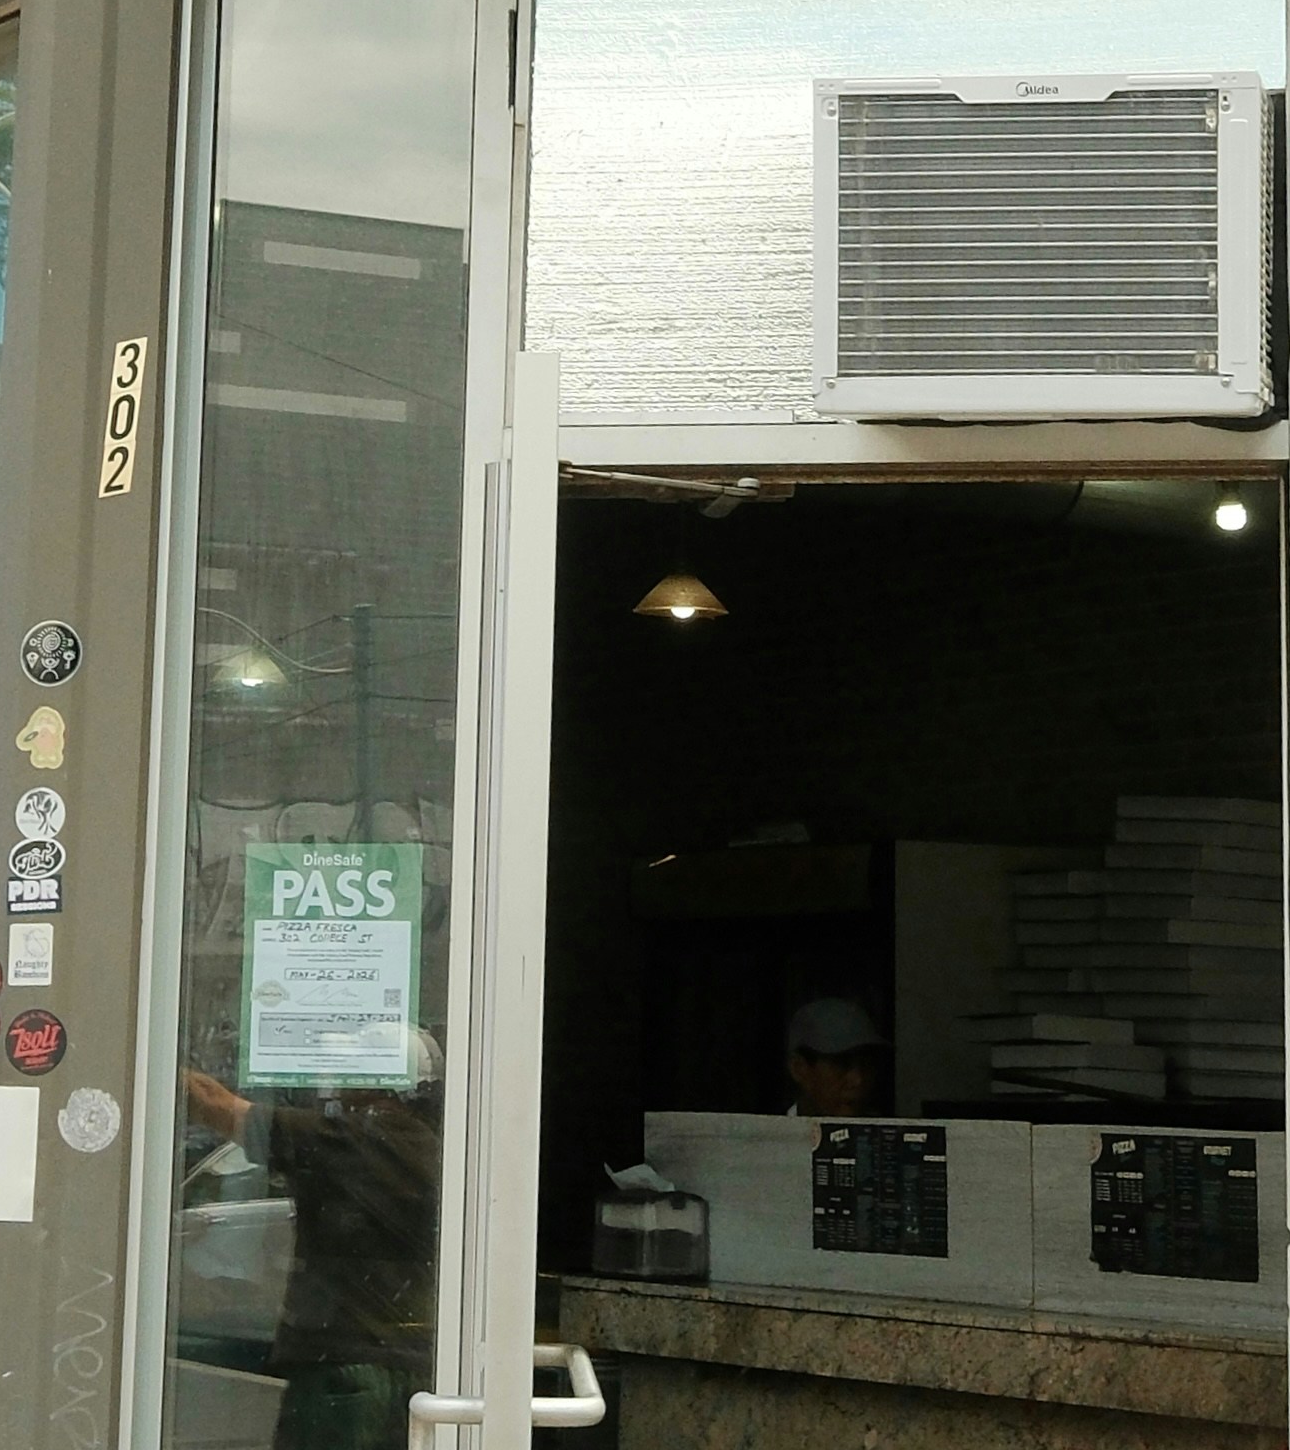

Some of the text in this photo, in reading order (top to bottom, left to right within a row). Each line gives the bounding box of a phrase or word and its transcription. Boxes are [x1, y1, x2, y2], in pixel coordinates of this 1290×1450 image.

[1015, 81, 1060, 98] Midea
[103, 342, 141, 494] 302
[303, 851, 364, 867] DineSafe
[8, 879, 60, 902] PDR
[272, 869, 396, 918] PASS
[276, 921, 358, 933] PIZZA FRESCA
